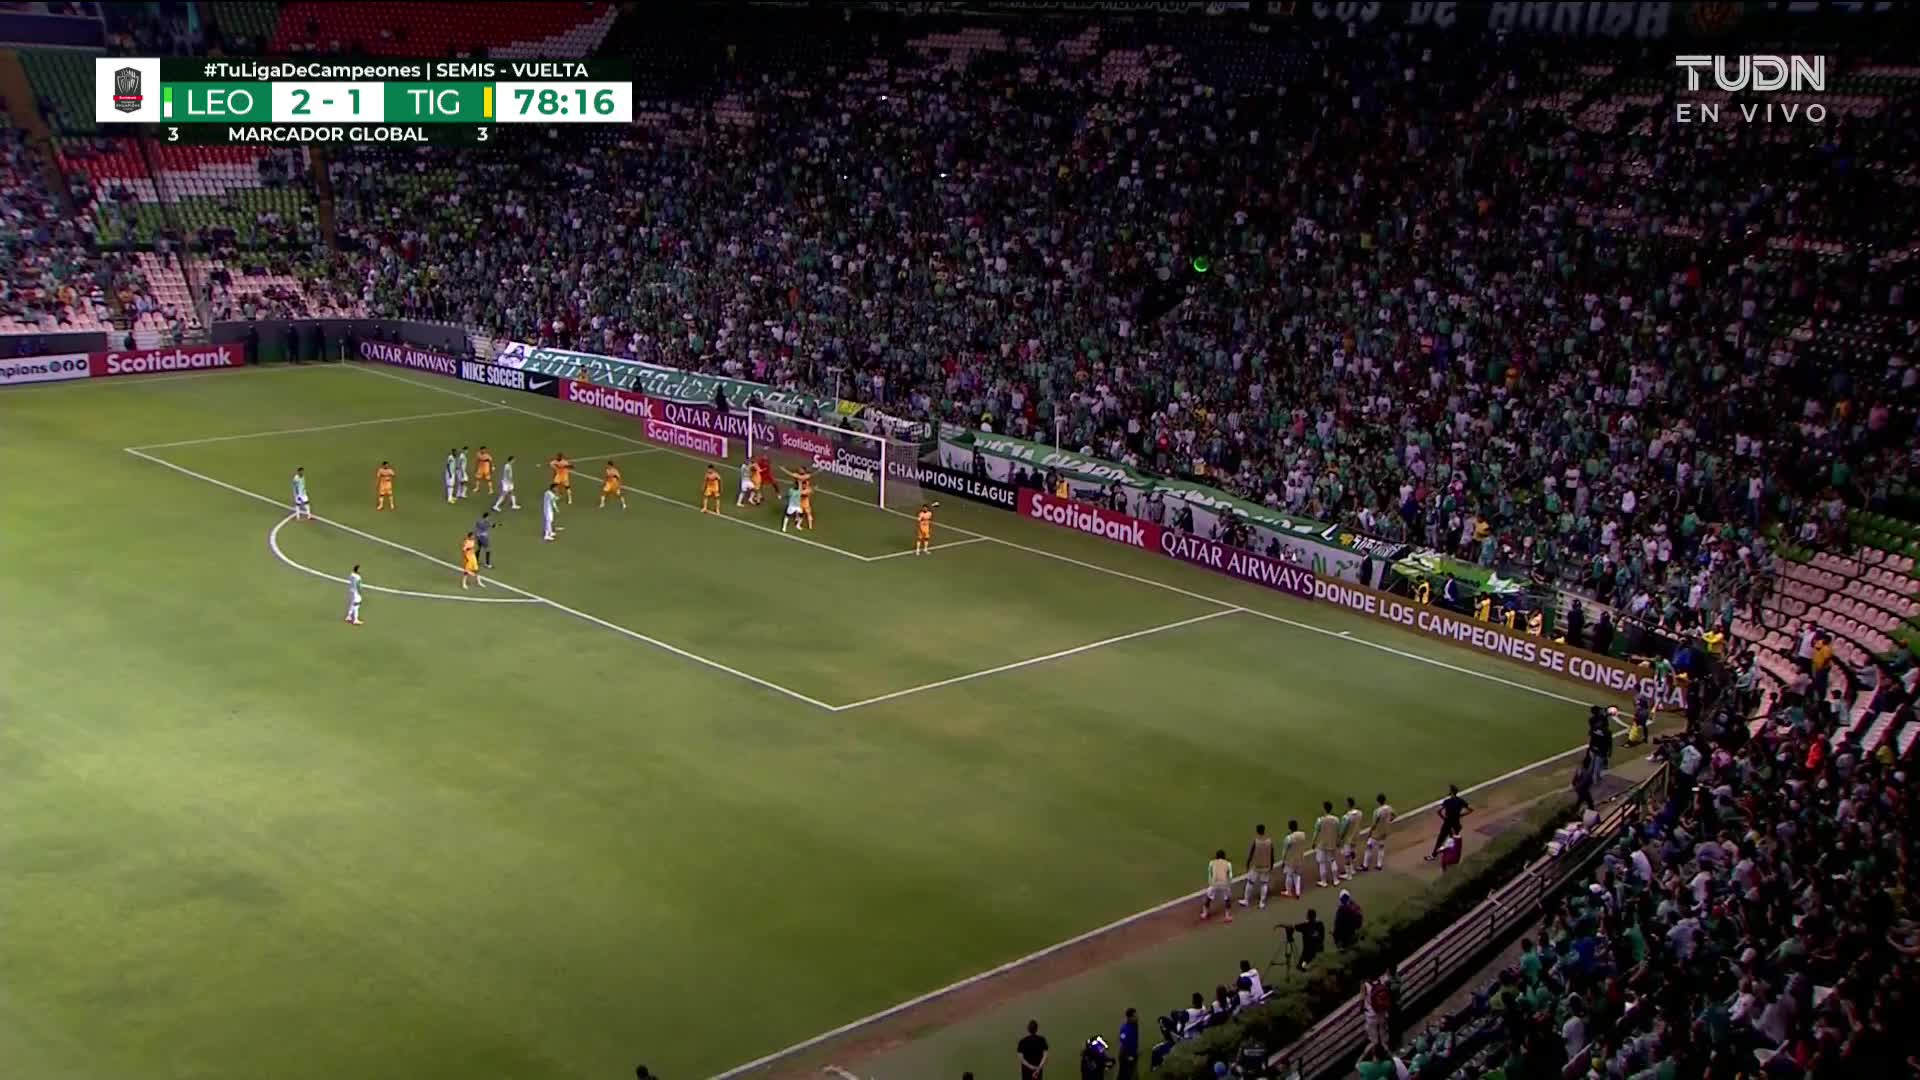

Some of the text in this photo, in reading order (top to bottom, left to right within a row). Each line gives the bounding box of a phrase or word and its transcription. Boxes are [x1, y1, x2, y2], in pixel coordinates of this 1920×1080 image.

[107, 347, 232, 375] Scotiabank
[361, 342, 456, 375] QATAR AIRWAYS
[462, 361, 486, 383] NIKE
[487, 366, 525, 390] SOCCER
[569, 381, 653, 418] Scotiabank
[648, 421, 719, 455] Scotiabank
[665, 403, 775, 442] QATAR AIRWAYS
[782, 433, 832, 457] Scotiabank
[812, 454, 874, 483] Scotiabank
[888, 461, 964, 493] CHAMPIONS
[967, 482, 1015, 506] LEAGUE
[1031, 493, 1145, 547] Scotiabank
[1161, 531, 1314, 597] QATAR AIRWAYS
[1314, 579, 1376, 614] DONDE
[1379, 602, 1414, 626] LOS
[1417, 611, 1535, 663] CAMPEONES
[1539, 646, 1564, 672] SE
